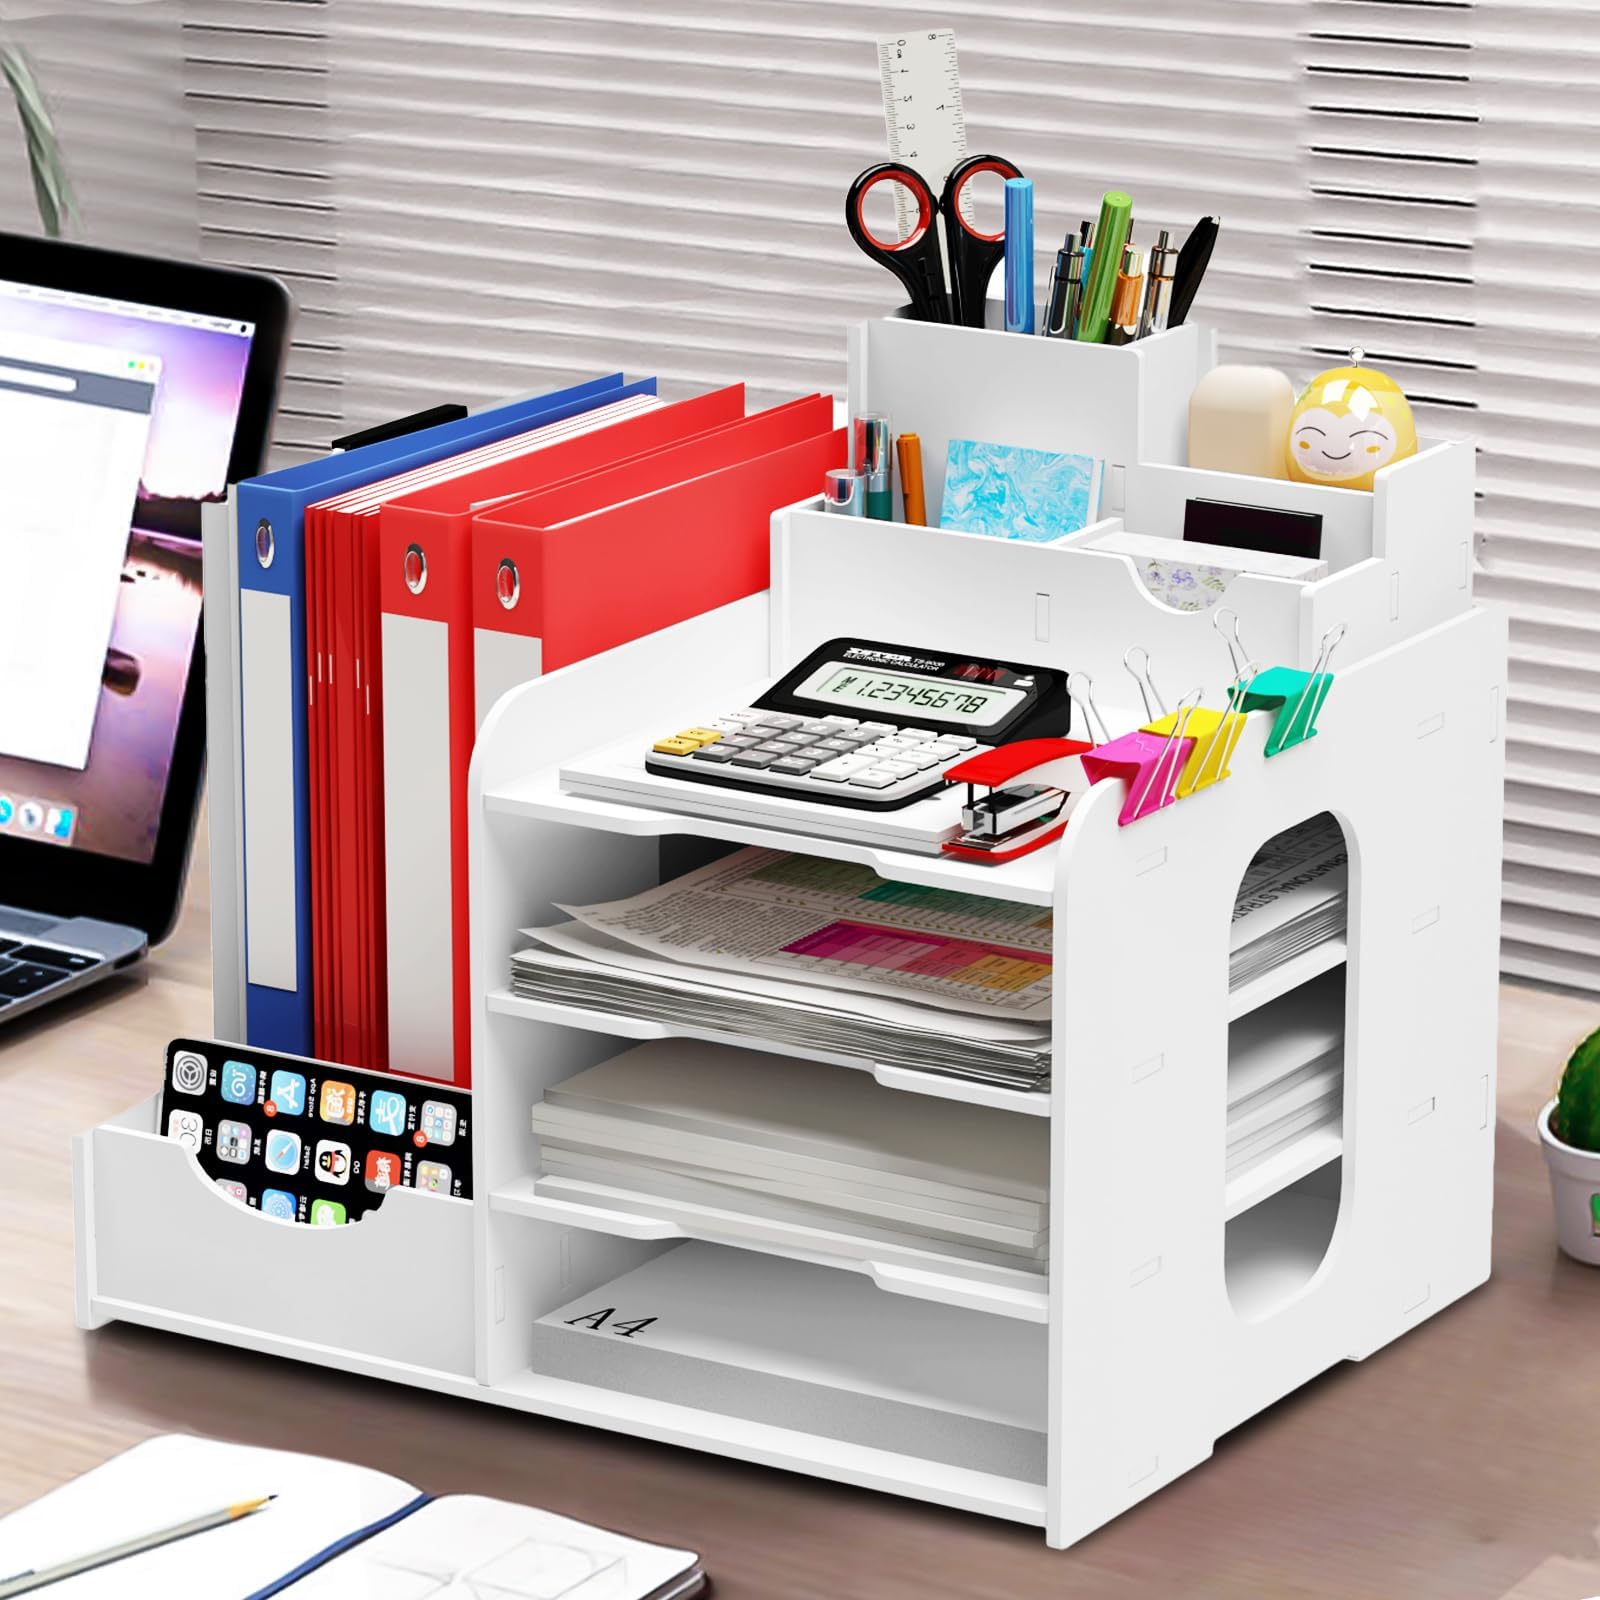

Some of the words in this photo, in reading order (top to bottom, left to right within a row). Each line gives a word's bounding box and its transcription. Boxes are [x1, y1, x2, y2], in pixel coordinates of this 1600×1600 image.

[890, 659, 940, 672] CALCULATOR
[856, 679, 988, 714] 1.2345678
[563, 1307, 659, 1338] A4
